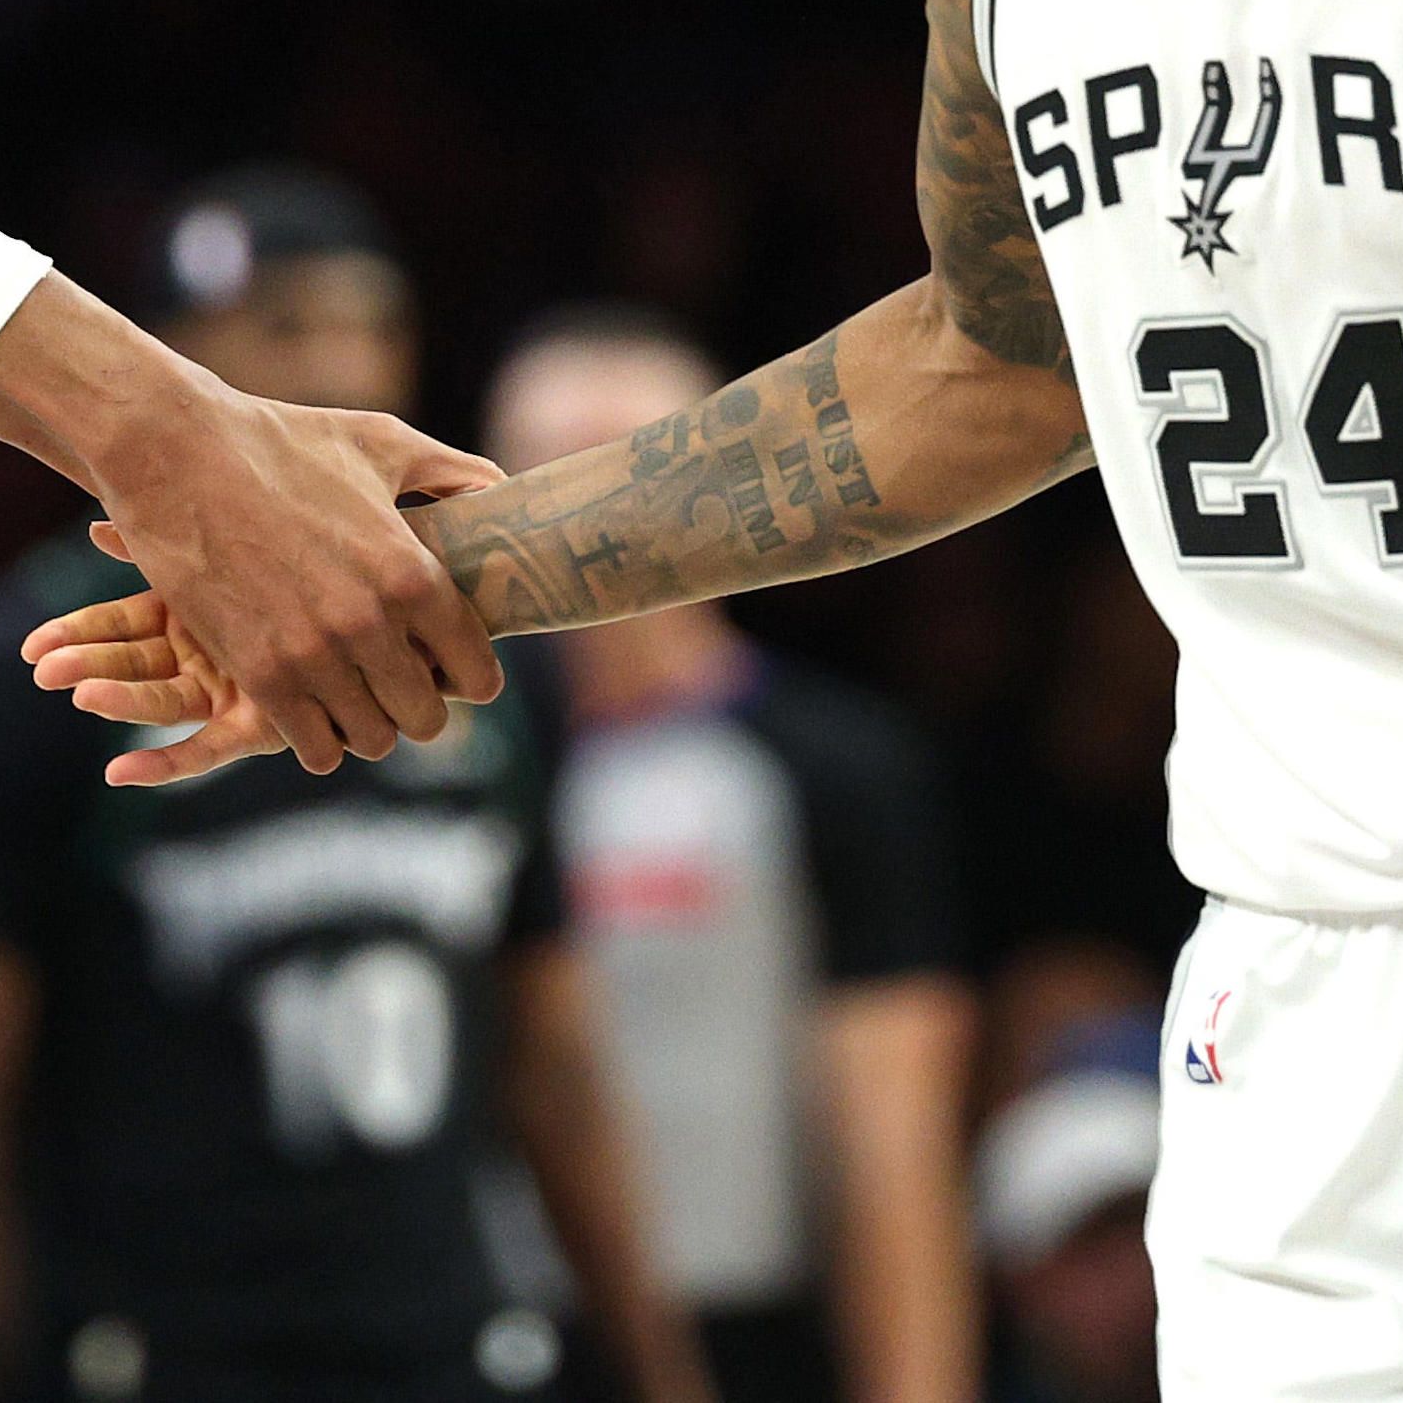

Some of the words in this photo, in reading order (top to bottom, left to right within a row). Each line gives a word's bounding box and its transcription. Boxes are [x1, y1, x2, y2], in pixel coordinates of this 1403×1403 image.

[773, 438, 824, 507] IN
[804, 331, 881, 507] TRUST
[718, 438, 787, 555] HIM
